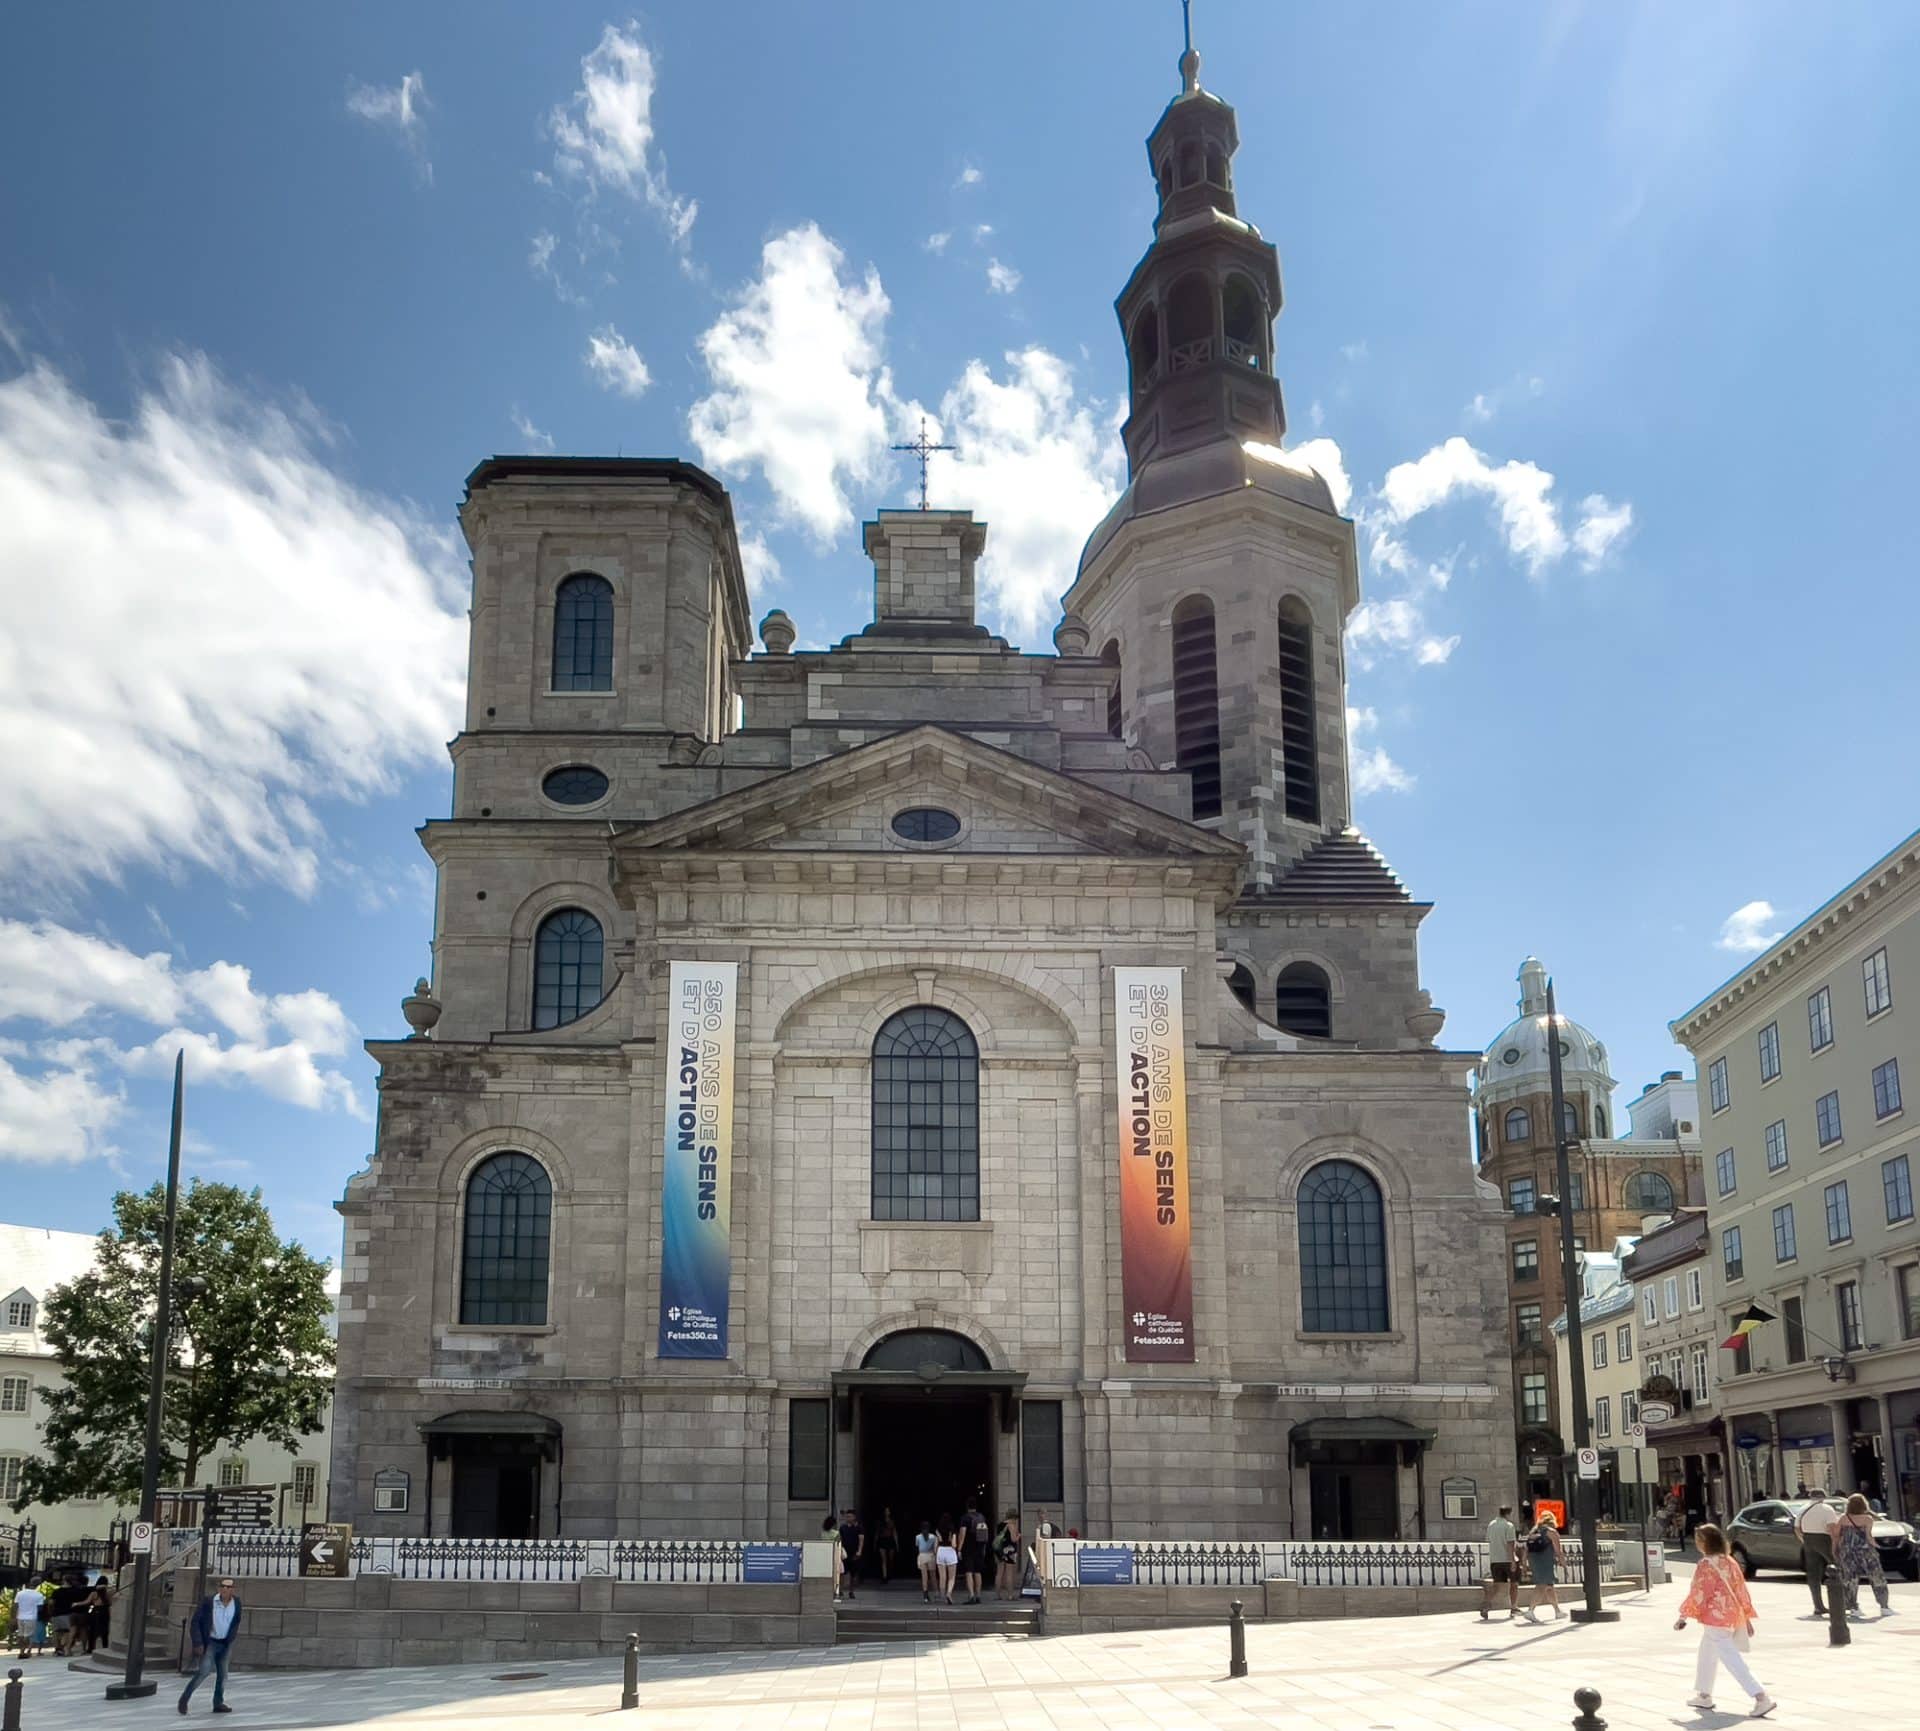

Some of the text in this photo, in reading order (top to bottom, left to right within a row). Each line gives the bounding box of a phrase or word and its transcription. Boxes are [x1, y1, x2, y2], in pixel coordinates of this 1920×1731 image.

[678, 980, 701, 1151] ET D'ACTION
[697, 980, 723, 1221] 350 ANS DE SENS
[1128, 985, 1151, 1157] ET D'ACTION
[1150, 985, 1176, 1226] 350 ANS DE SENS
